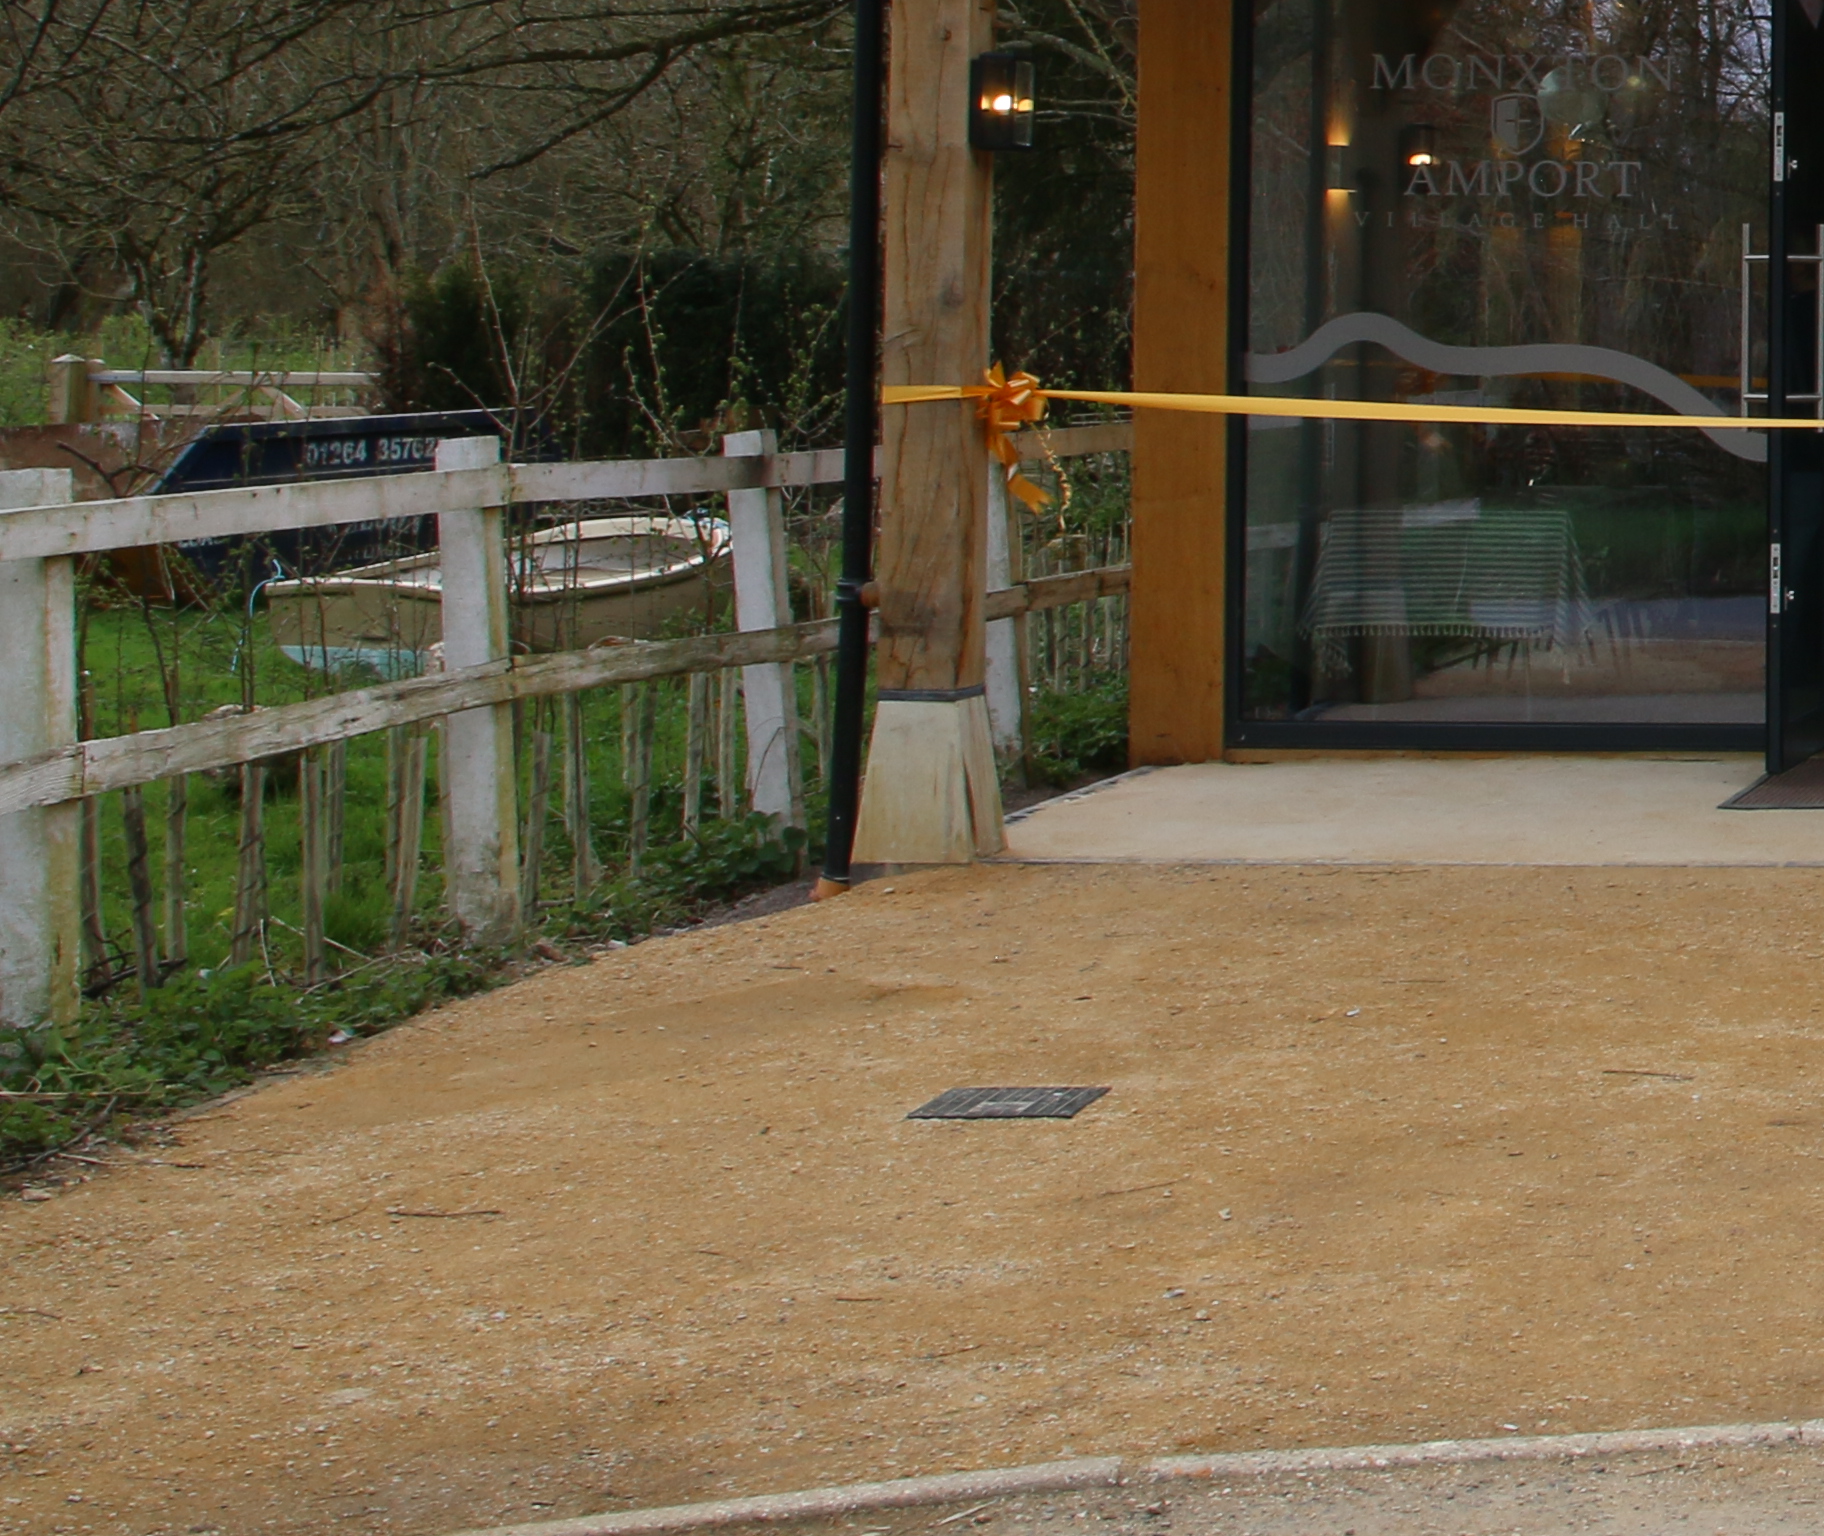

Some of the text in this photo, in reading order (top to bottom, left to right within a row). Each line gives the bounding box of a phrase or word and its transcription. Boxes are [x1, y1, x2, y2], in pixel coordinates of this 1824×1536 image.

[1369, 52, 1674, 91] MONXTON
[1403, 159, 1641, 197] AMPORT
[1354, 210, 1679, 230] VILLAGE HALL
[306, 439, 368, 466] 01264
